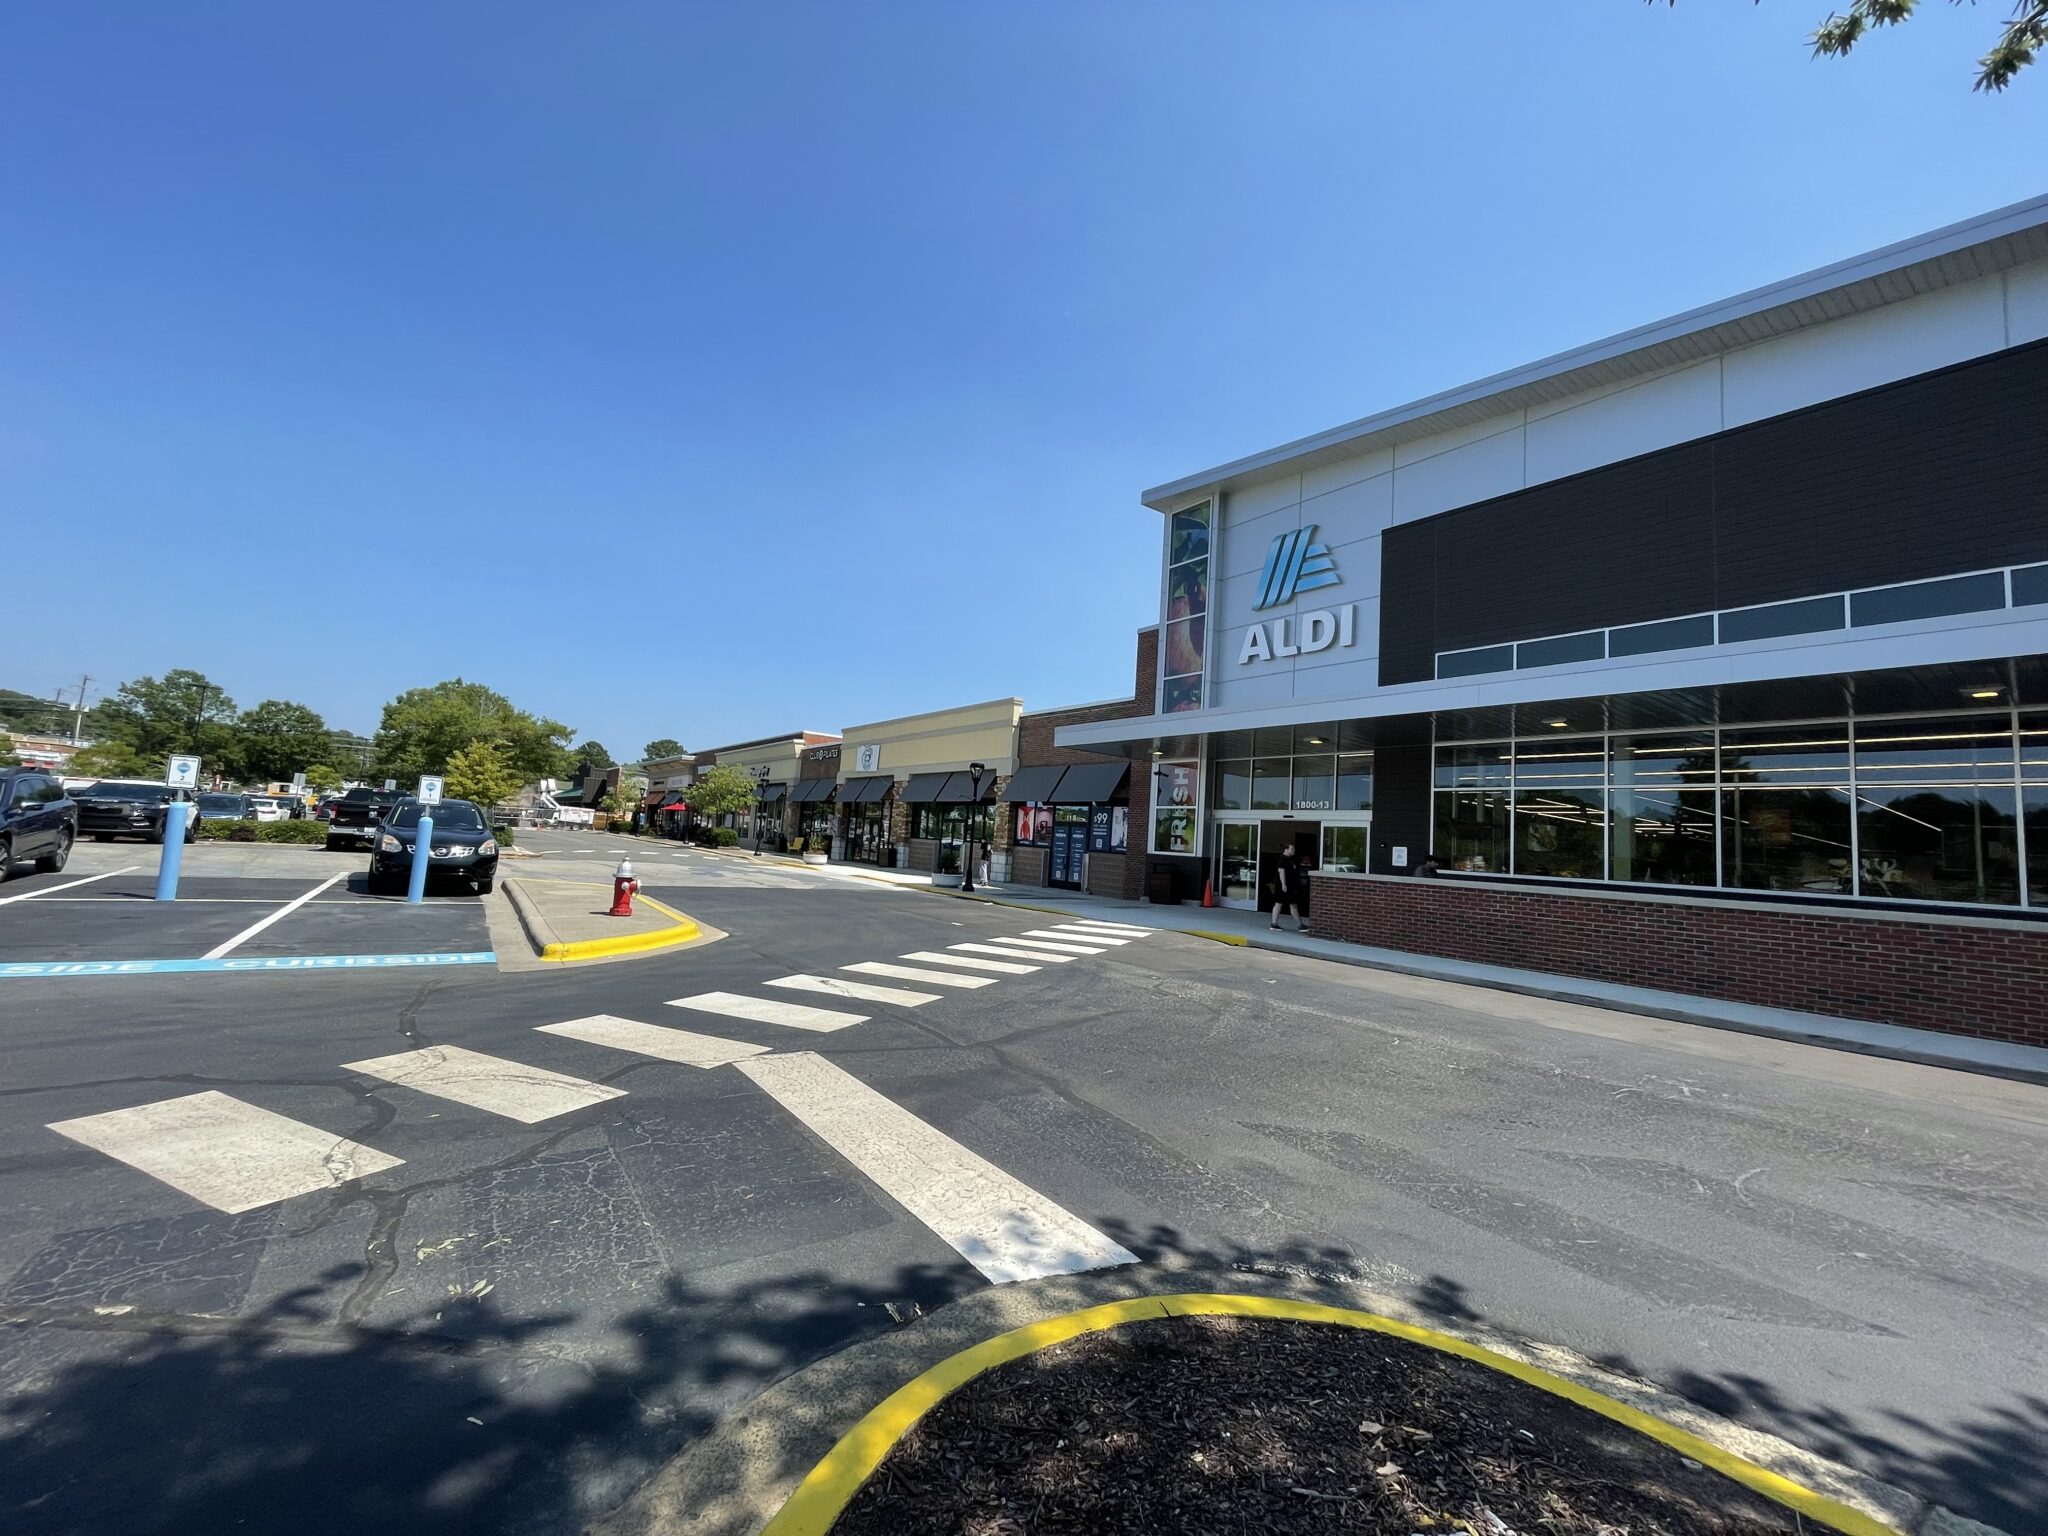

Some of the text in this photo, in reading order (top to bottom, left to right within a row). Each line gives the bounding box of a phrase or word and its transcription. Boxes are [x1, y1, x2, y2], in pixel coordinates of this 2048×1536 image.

[1237, 604, 1356, 665] ALDI
[1170, 767, 1190, 850] FRESH
[1296, 800, 1330, 809] 1800-13
[1093, 812, 1108, 824] $99
[223, 953, 489, 967] CURBSIDE
